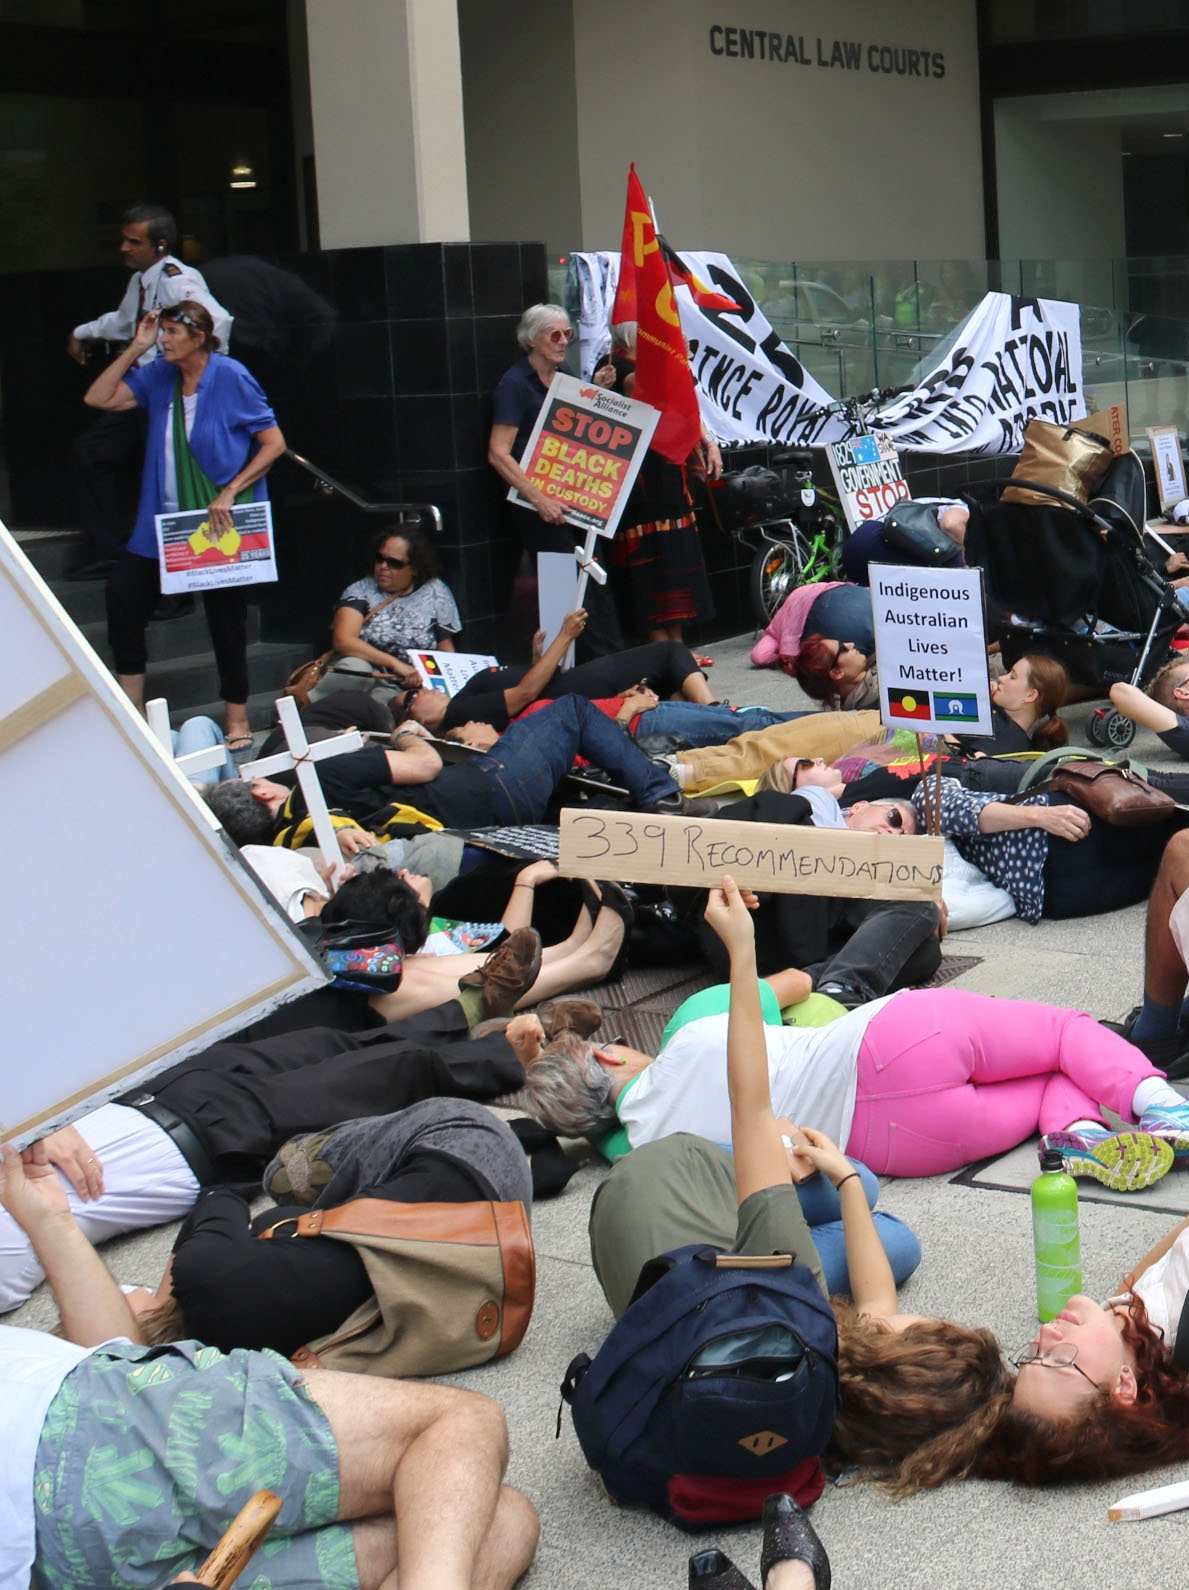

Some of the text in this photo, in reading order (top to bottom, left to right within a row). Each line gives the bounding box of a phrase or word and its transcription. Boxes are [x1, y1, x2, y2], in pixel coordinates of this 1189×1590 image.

[710, 24, 946, 79] CENTRAL LAW COURTS
[593, 401, 628, 418] Alliance
[595, 393, 632, 411] Socialist
[551, 407, 633, 450] STOP
[541, 437, 622, 481] BLACK
[530, 476, 607, 513] IN CUSTODY
[534, 458, 613, 499] DEATHS
[856, 480, 909, 519] STOP
[879, 581, 970, 601] Indigenous
[885, 609, 968, 629] Australian
[908, 638, 948, 655] Lives
[899, 664, 963, 682] Matter!
[572, 816, 666, 868] 339
